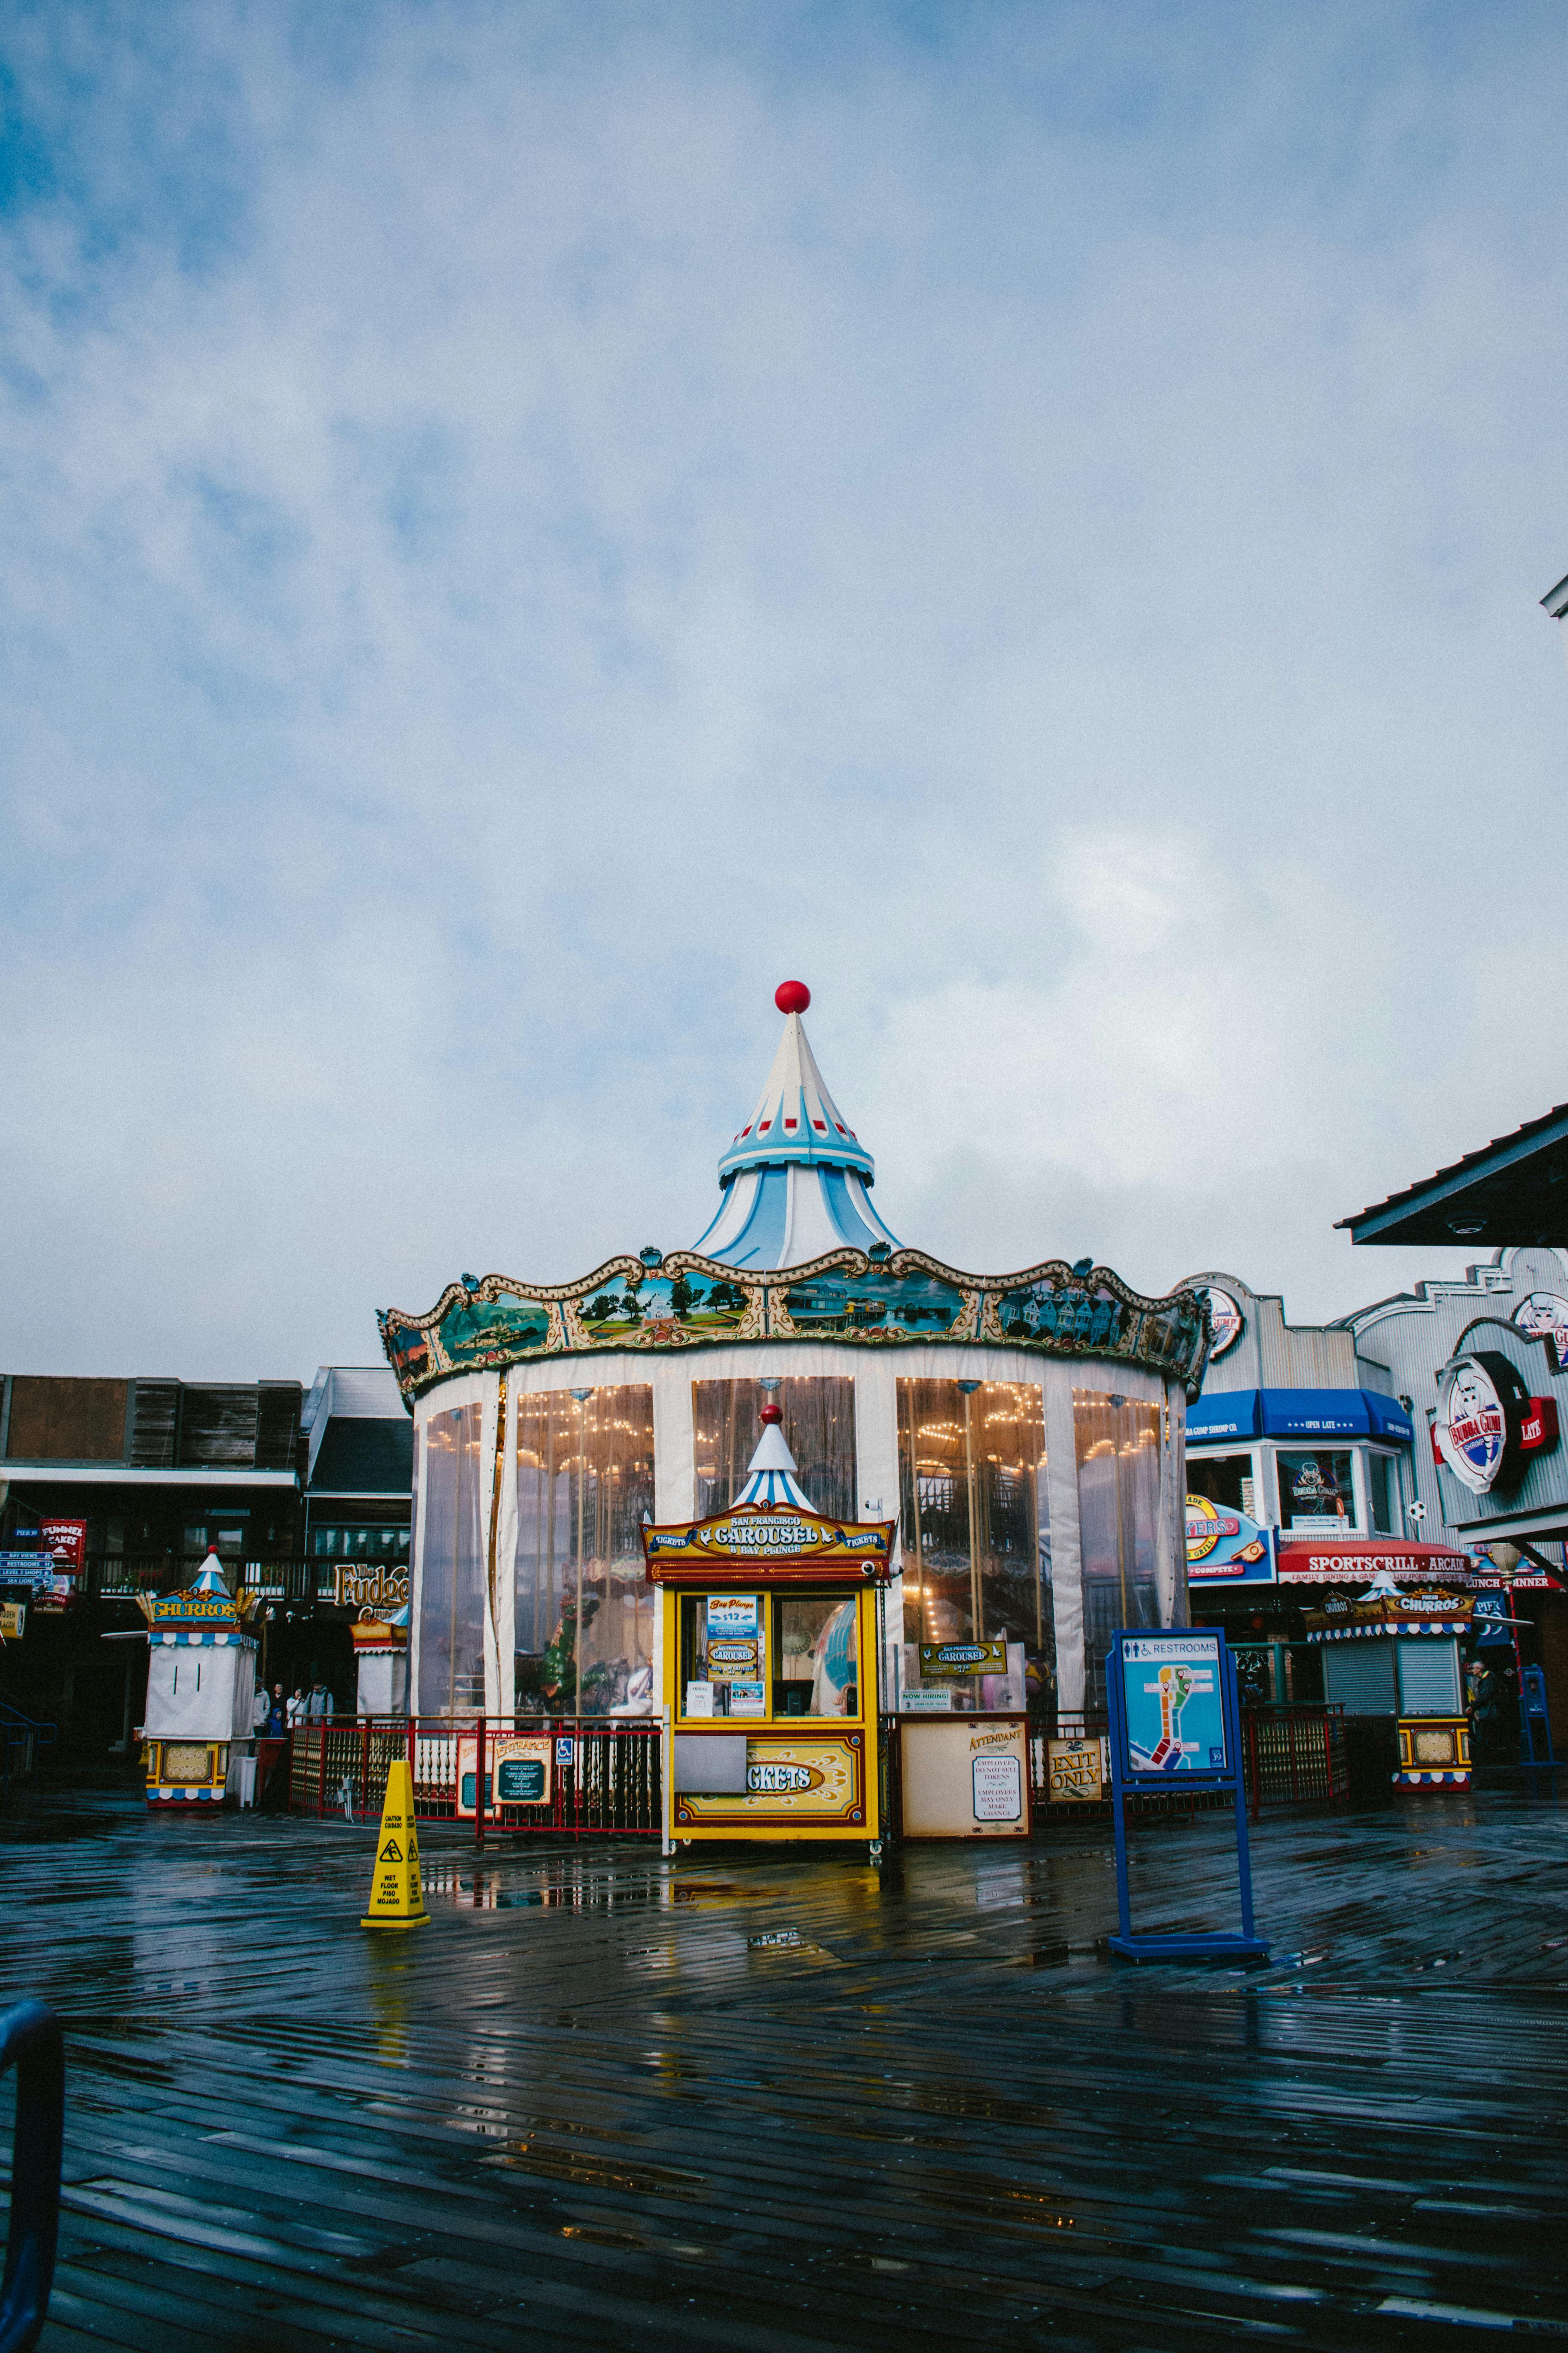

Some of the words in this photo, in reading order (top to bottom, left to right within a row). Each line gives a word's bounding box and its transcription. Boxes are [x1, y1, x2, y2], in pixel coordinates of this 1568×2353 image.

[1193, 1426, 1208, 1435] GUMP
[1208, 1425, 1229, 1434] SHRIMP
[1450, 1418, 1481, 1444] BUBBA
[1480, 1414, 1501, 1432] GUM
[1522, 1419, 1541, 1440] LATE
[1464, 1438, 1484, 1452] SHRIMP
[731, 1517, 750, 1527] SAN
[751, 1516, 801, 1526] FRANCISCO
[42, 1525, 83, 1537] FUNNEL
[1185, 1521, 1226, 1536] YERS
[48, 1536, 78, 1545] CAKES
[655, 1536, 686, 1546] TICKETS
[715, 1527, 819, 1545] CAROUSEL
[846, 1535, 878, 1547] TICKETS
[740, 1546, 761, 1555] BAY
[763, 1545, 801, 1555] PLUNGE
[1194, 1540, 1213, 1557] GRILL
[1195, 1566, 1233, 1574] COMPETE
[1429, 1557, 1465, 1571] ARCADE
[357, 1564, 374, 1577] The
[334, 1564, 409, 1608] Fudge
[1466, 1579, 1501, 1588] LUNCH
[1513, 1577, 1549, 1587] INNER
[152, 1602, 237, 1618] CHURROS
[710, 1600, 727, 1609] Bay
[728, 1599, 754, 1609] Plunge
[1325, 1601, 1348, 1613] CHURROS
[1400, 1597, 1459, 1612] CHURROS
[723, 1613, 740, 1621] $12
[1153, 1643, 1216, 1653] RESTROOMS
[713, 1651, 753, 1660] CAROUSEL
[938, 1651, 984, 1662] CAROUSEL
[969, 1729, 1022, 1751] ATTENDANT
[495, 1740, 550, 1758] ENTRANCE
[1052, 1750, 1096, 1772] EXIT
[1212, 1753, 1222, 1761] 39
[747, 1766, 811, 1791] CKETS
[1051, 1767, 1100, 1790] ONLY
